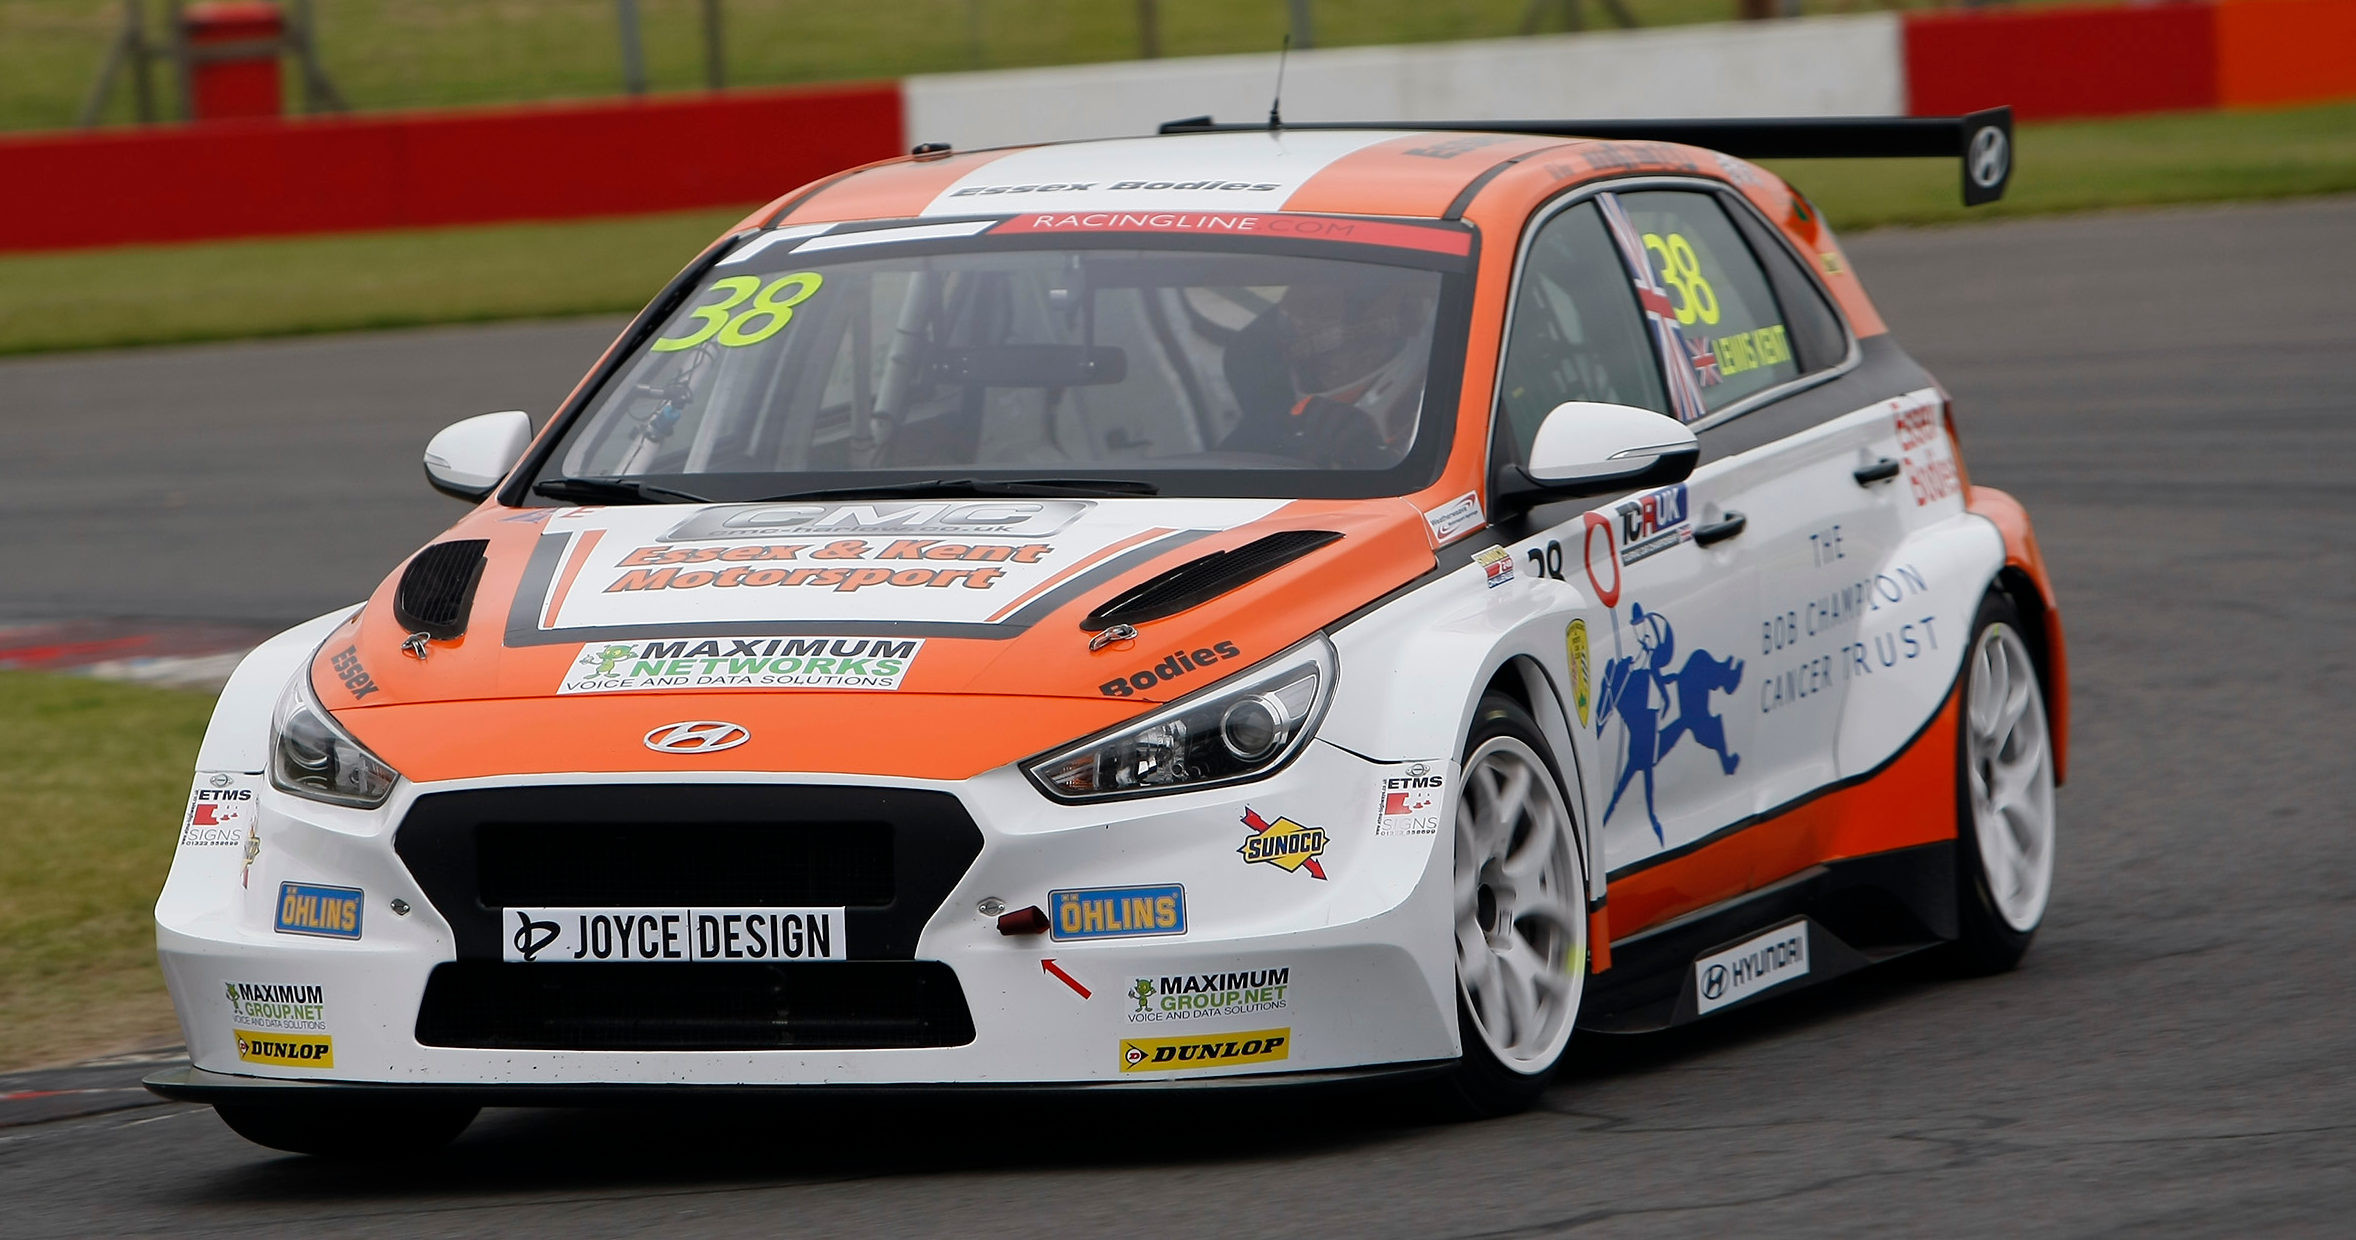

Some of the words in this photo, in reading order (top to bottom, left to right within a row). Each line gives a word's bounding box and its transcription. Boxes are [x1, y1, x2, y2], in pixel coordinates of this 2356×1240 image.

[949, 182, 1100, 197] Essex
[1106, 180, 1282, 192] Bodies
[1641, 233, 1720, 325] 38
[650, 272, 823, 351] 38
[1712, 332, 1758, 376] LEWIS
[1752, 325, 1792, 366] KENT
[722, 503, 1044, 527] CMC
[614, 544, 814, 568] Essex
[809, 539, 873, 560] &
[873, 539, 1055, 564] Kent
[1809, 524, 1845, 569] THE
[601, 566, 1007, 593] Motorsport
[1762, 610, 1798, 656] BOB
[1806, 563, 1928, 637] CHAMPION
[640, 639, 917, 660] MAXIMUM
[331, 644, 379, 700] Essex
[630, 658, 903, 677] NETWORKS
[1099, 640, 1241, 697] Bodies
[1761, 655, 1834, 714] CANCER
[1841, 615, 1939, 681] TRUST
[566, 678, 637, 691] VOICE
[640, 676, 689, 688] AND
[696, 675, 753, 686] DATA
[759, 675, 894, 688] SOLUTIONS
[198, 789, 252, 801] ETMS
[1387, 776, 1443, 790] ETMS
[188, 828, 242, 842] SIGNS
[1382, 816, 1438, 831] SIGNS
[1248, 831, 1322, 859] SUNOCO
[282, 886, 358, 932] ÖHLINS
[1060, 893, 1178, 934] ÖHLINS
[573, 914, 681, 960] JOYCE
[698, 913, 831, 959] DESIGN
[1732, 935, 1803, 988] HYUNDAI
[238, 983, 323, 1004] MAXIMUM
[1160, 967, 1289, 995] MAXIMUM
[245, 1002, 324, 1021] GROUP.NET
[1127, 1012, 1163, 1023] VOICE
[1165, 1010, 1191, 1021] AND
[1193, 1008, 1222, 1018] DATA
[1224, 999, 1287, 1016] SOLUTIONS
[1160, 985, 1288, 1012] GROUP.NET
[234, 1015, 250, 1025] VOICE
[251, 1017, 265, 1027] AND
[265, 1019, 282, 1028] DATA
[282, 1020, 326, 1030] SOLUTIONS
[251, 1040, 329, 1060] DUNLOP
[1151, 1036, 1285, 1063] DUNLOP
